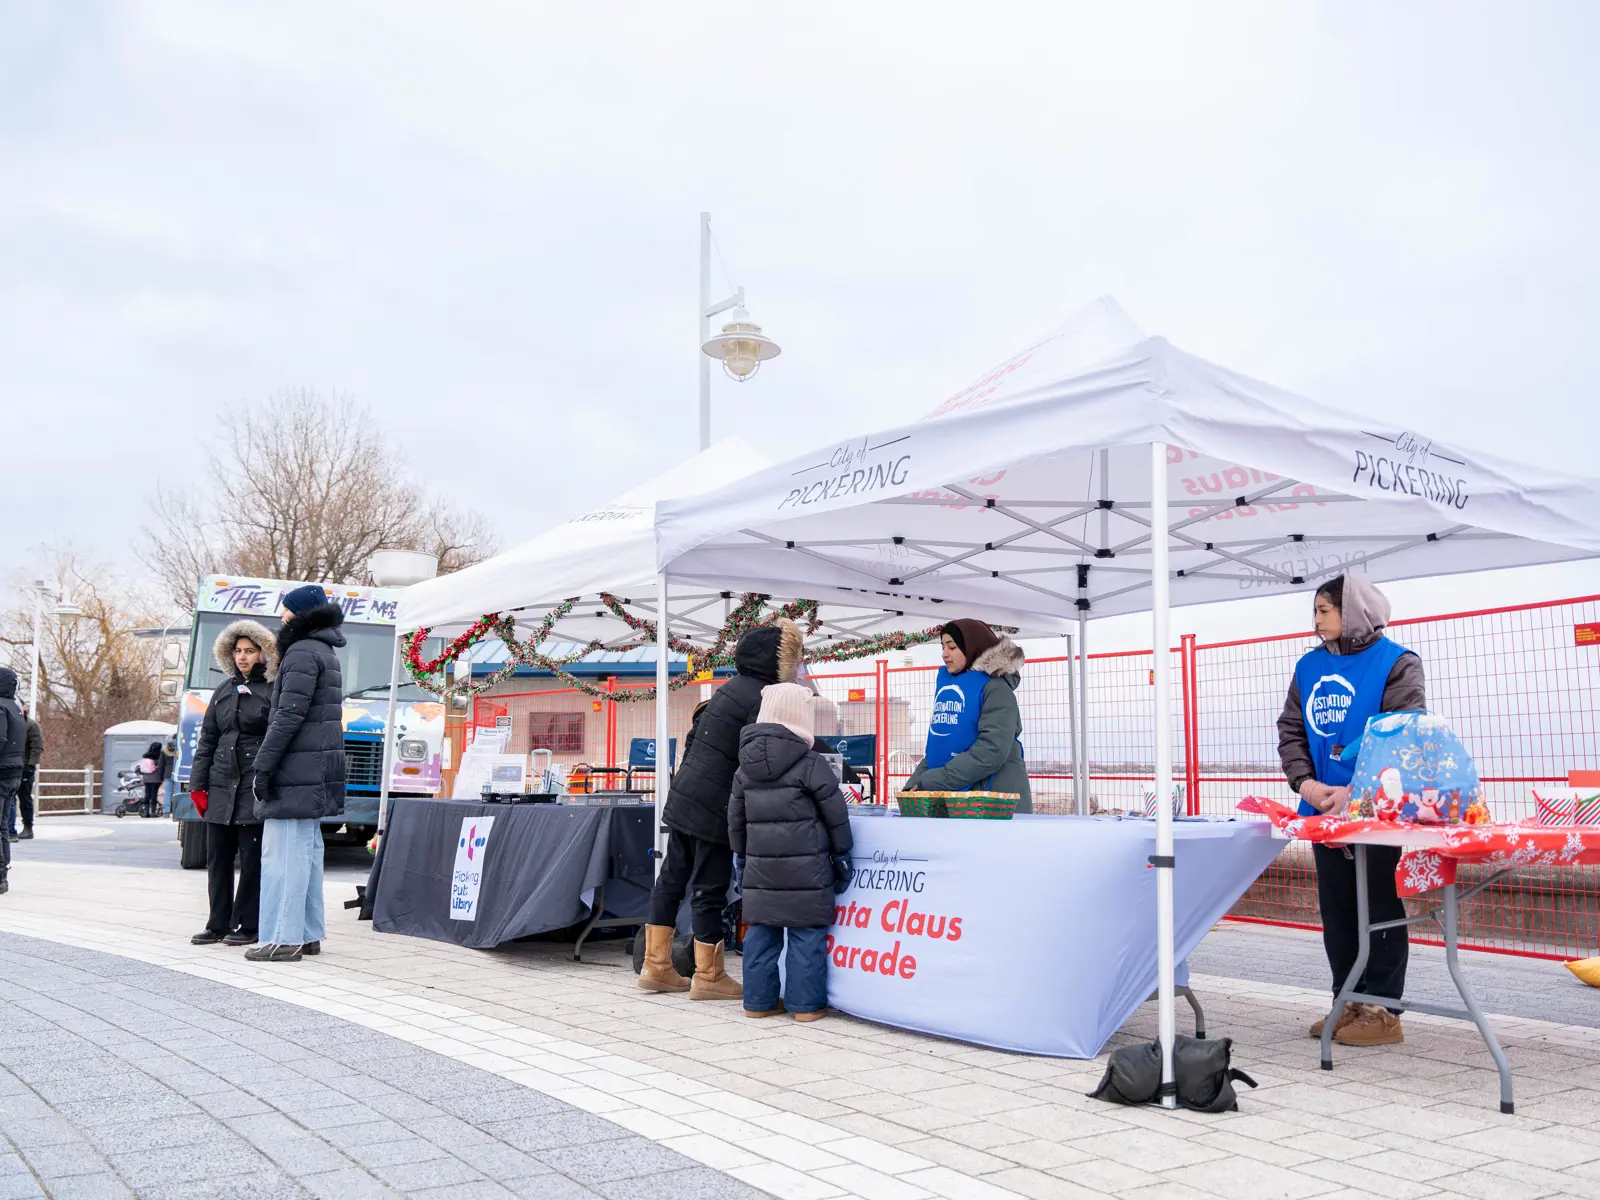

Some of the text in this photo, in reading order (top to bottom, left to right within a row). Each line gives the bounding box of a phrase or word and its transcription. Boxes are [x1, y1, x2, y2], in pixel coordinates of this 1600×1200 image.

[830, 436, 868, 472] City of
[1396, 431, 1432, 463] City of
[777, 455, 911, 510] PICKERING
[1353, 450, 1468, 509] PICKERING
[872, 849, 900, 869] City of
[850, 868, 926, 893] PICKERING
[832, 898, 963, 942] nta Claus
